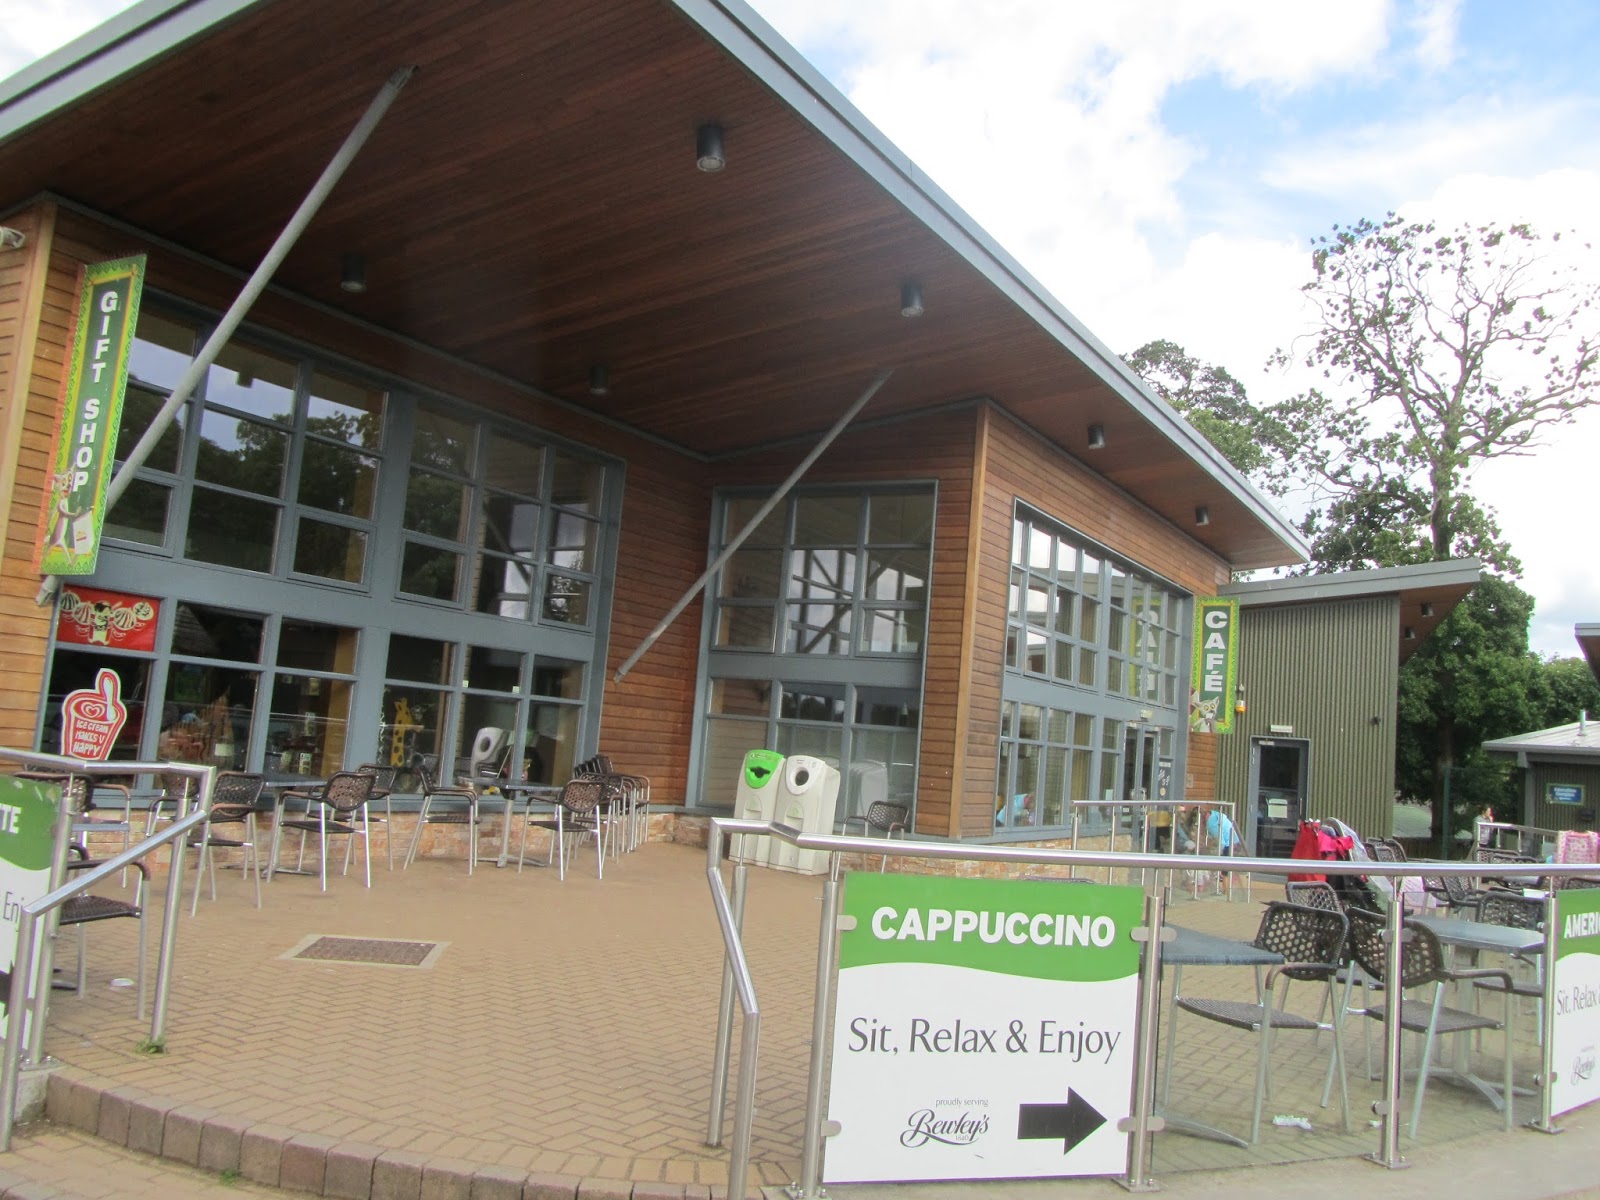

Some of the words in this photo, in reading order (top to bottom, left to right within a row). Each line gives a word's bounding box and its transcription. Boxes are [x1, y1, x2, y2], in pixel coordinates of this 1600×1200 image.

[92, 290, 119, 384] GIFT
[72, 398, 100, 493] SHOP
[1204, 610, 1228, 692] CAFÉ
[0, 802, 22, 834] TE
[871, 906, 1116, 948] CAPPUCCINO
[1563, 911, 1600, 939] AMERI
[848, 1017, 899, 1056] Sit,
[909, 1018, 997, 1053] Relax
[1005, 1019, 1029, 1054] &
[1039, 1020, 1121, 1064] Enjoy
[935, 1097, 963, 1108] proudly
[963, 1097, 989, 1108] serving
[900, 1108, 990, 1148] Bewley's
